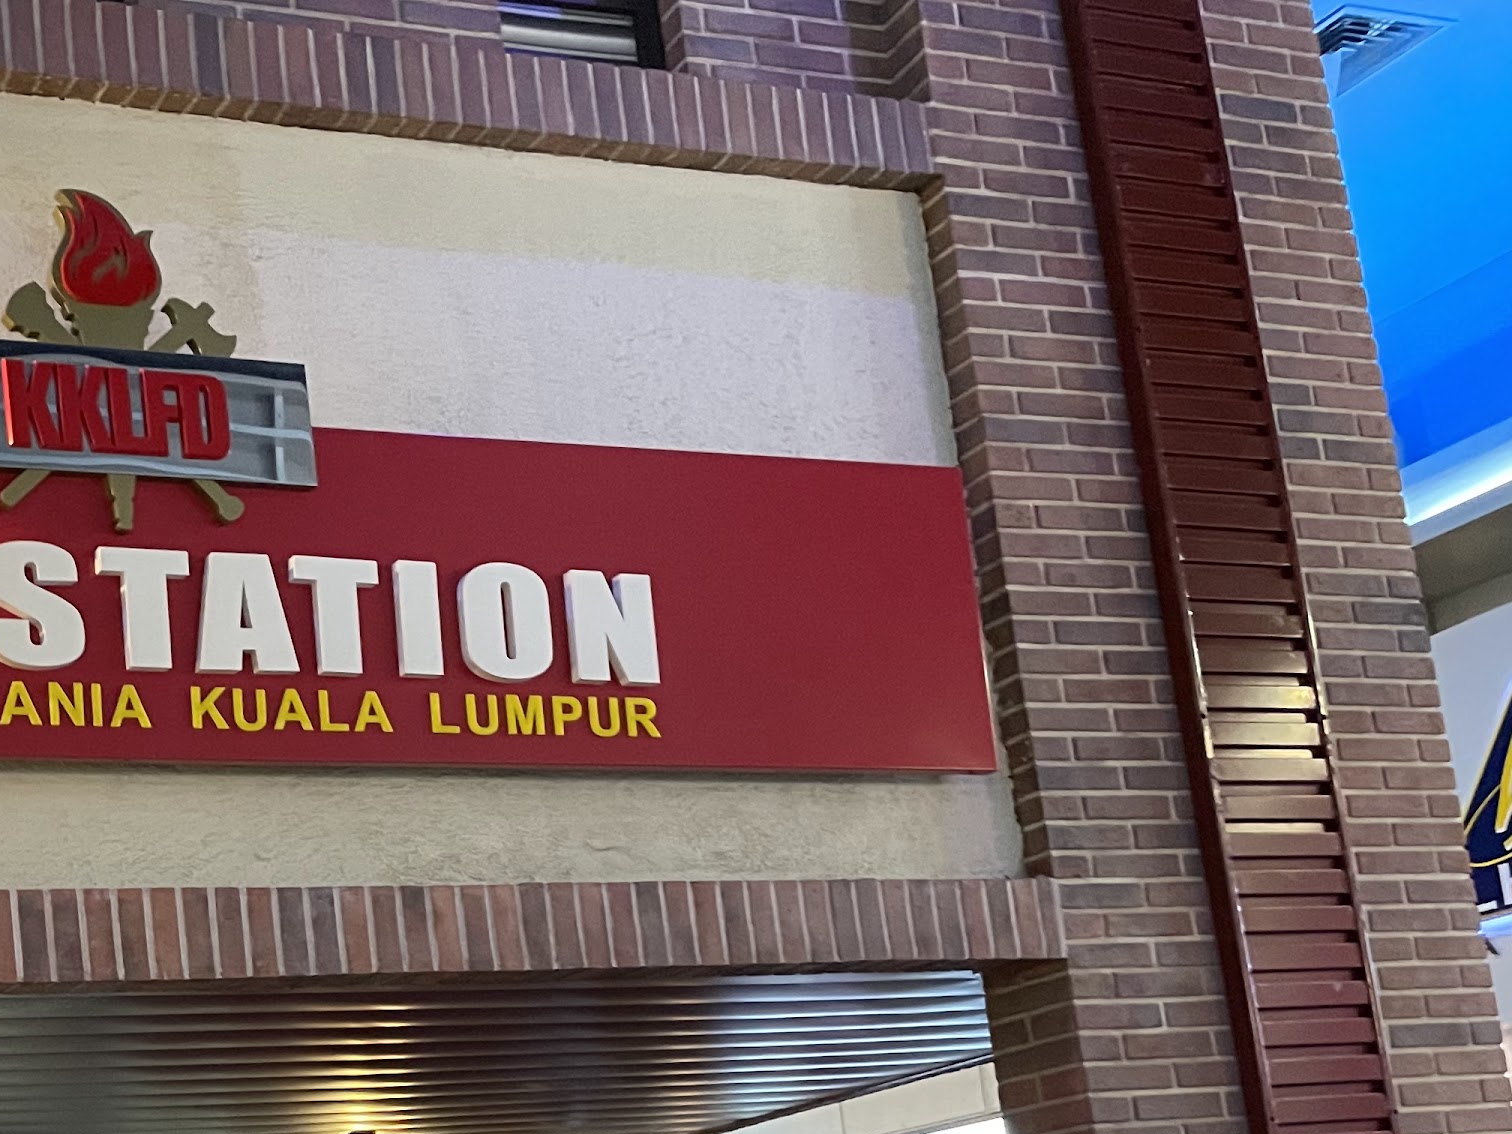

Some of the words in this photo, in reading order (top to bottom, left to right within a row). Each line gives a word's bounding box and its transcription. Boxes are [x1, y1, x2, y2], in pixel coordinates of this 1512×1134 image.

[0, 356, 231, 461] KKLFD
[189, 684, 392, 734] KUALA
[428, 691, 662, 739] LUMPUR
